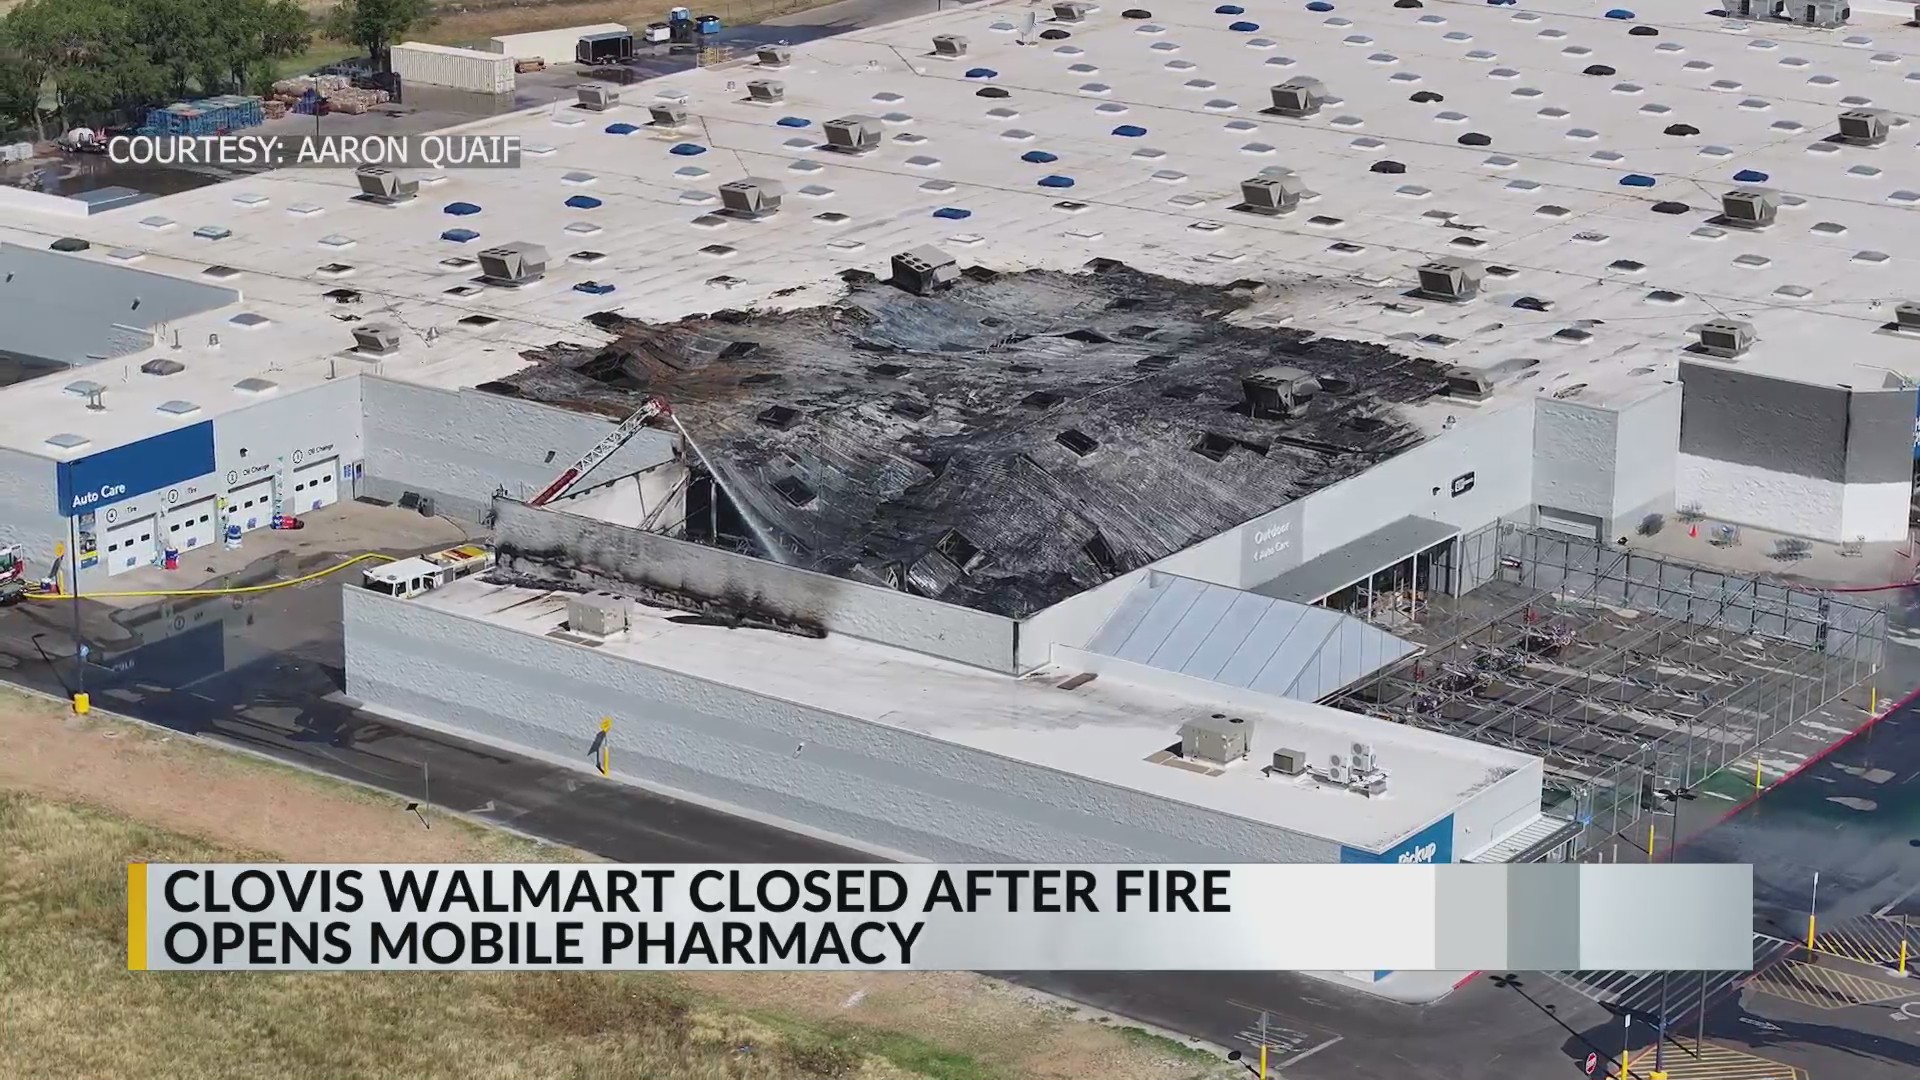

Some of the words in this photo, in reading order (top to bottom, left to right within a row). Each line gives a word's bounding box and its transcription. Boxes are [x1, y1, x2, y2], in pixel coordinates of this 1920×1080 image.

[72, 492, 99, 508] Auto
[100, 484, 126, 498] Care
[1254, 522, 1290, 545] Outdoor
[1398, 842, 1437, 864] Pickup
